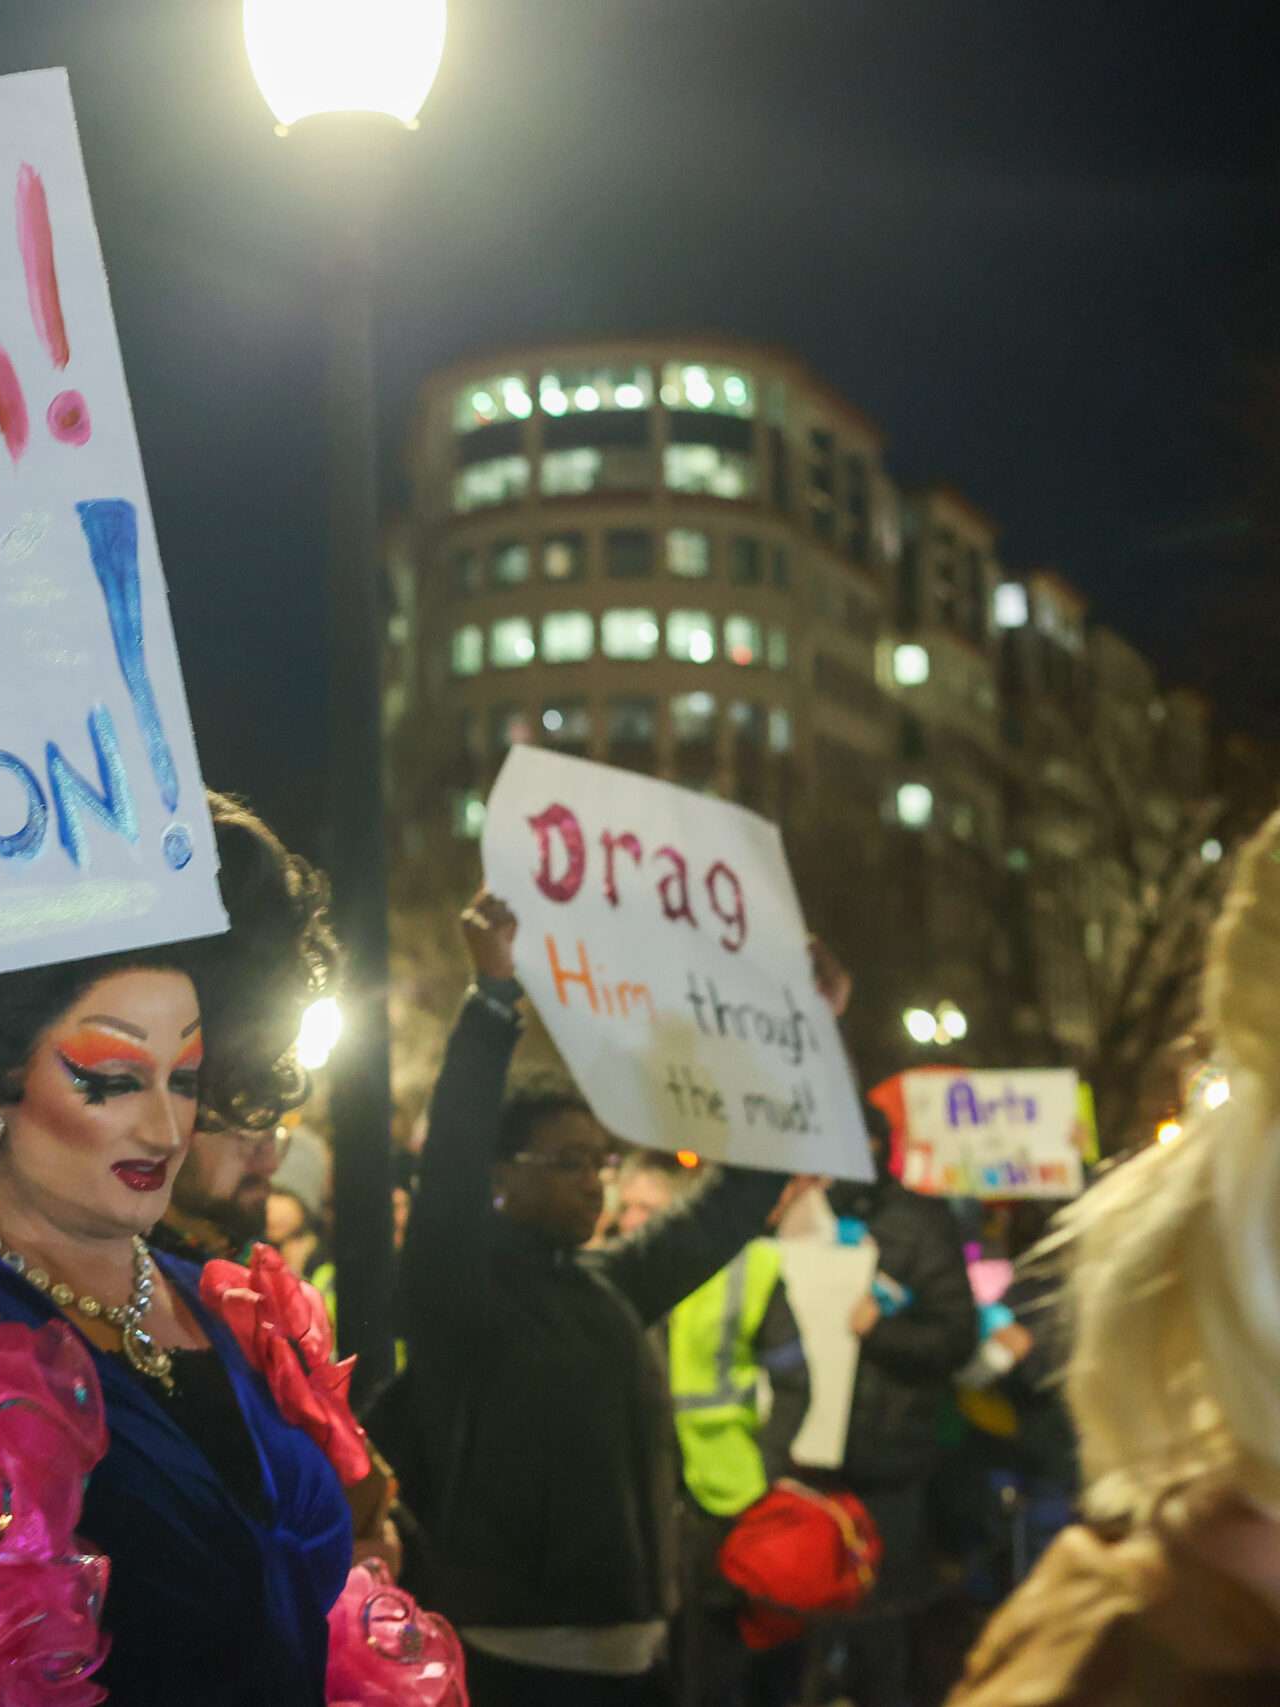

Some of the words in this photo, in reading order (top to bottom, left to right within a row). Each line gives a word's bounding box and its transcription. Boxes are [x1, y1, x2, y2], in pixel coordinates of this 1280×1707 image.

[526, 803, 748, 953] Drag
[544, 934, 658, 1023] Him
[665, 1064, 728, 1123] the
